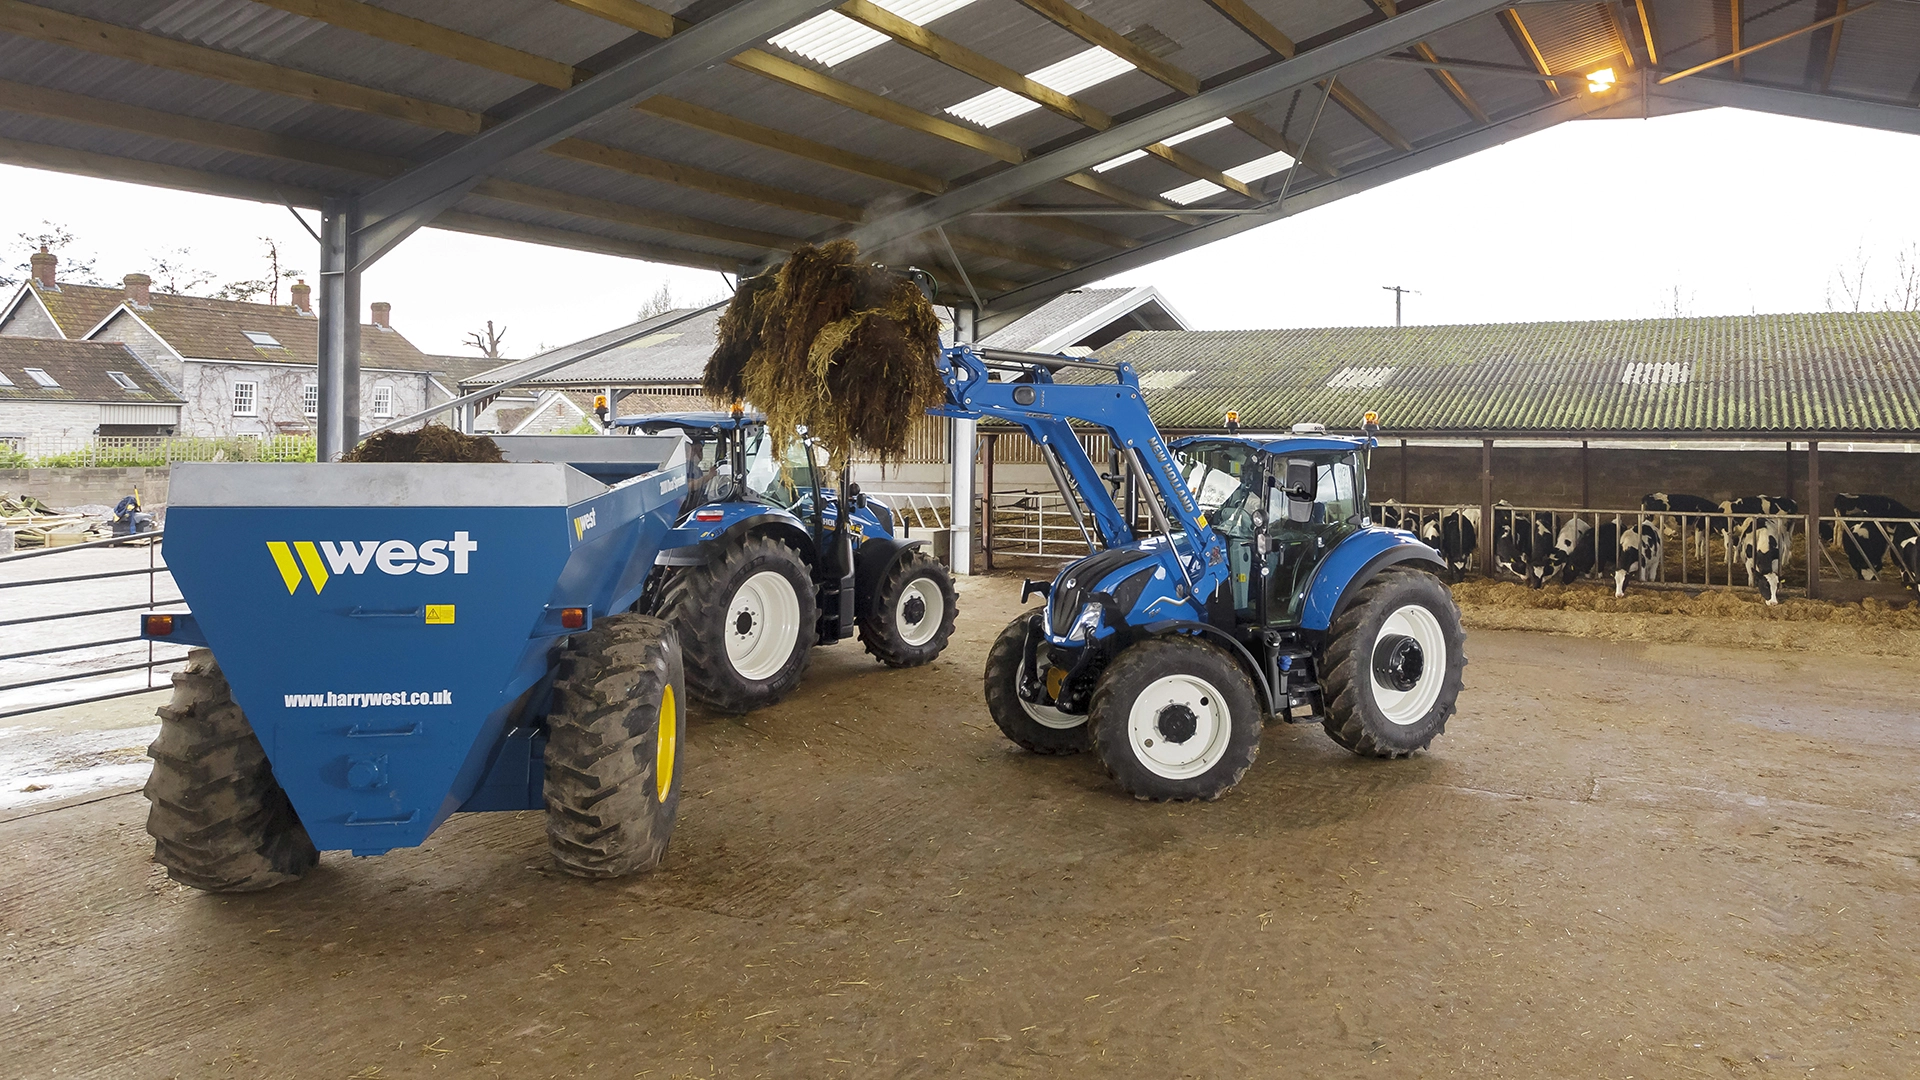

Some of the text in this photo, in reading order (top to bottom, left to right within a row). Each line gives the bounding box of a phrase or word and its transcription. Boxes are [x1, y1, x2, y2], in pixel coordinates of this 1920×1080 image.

[1147, 436, 1195, 513] NEW HOLLAND
[580, 507, 596, 531] west
[319, 531, 478, 575] west
[284, 689, 453, 708] www.harrywest.co.uk
